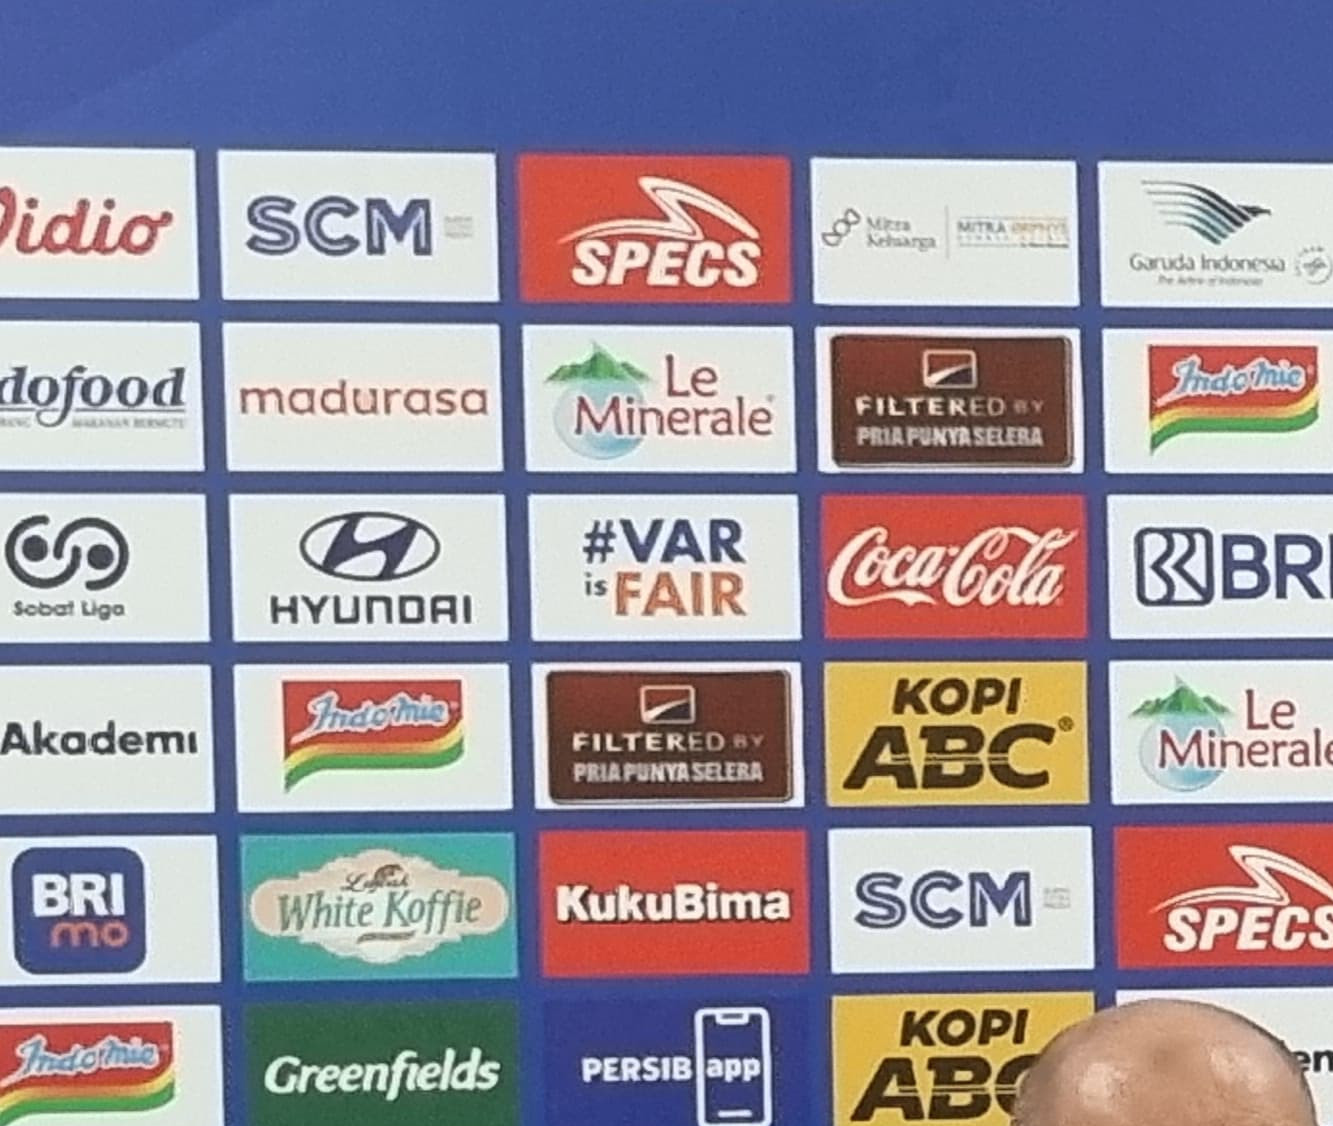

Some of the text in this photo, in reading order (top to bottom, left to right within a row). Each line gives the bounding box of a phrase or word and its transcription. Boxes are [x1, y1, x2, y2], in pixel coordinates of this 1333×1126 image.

[247, 196, 432, 255] SCM
[572, 239, 761, 288] SPECS
[666, 354, 716, 396] Le
[1155, 354, 1305, 402] Indomie
[0, 367, 186, 429] dofood
[240, 380, 488, 416] madurasa
[575, 396, 773, 436] Minerale
[856, 396, 1004, 416] FILTERED
[583, 520, 744, 563] #VAR
[827, 524, 1076, 607] Coca-Cola
[272, 595, 472, 624] HYUNDAI
[585, 573, 744, 617] is FAIR
[291, 691, 448, 742] Indomie
[892, 678, 1022, 714] KOPI
[1246, 690, 1295, 730] Le
[0, 722, 197, 756] Akademi
[573, 732, 725, 752] FILTERED
[843, 724, 1057, 790] ABC
[33, 874, 123, 917] BRI
[278, 887, 482, 930] White Koffie
[557, 887, 789, 923] KukuBima
[855, 871, 1032, 928] SCM
[51, 923, 129, 948] mo
[900, 1009, 1028, 1046] KOPI
[5, 1036, 159, 1088] Indomie
[264, 1048, 500, 1102] Greenfields
[582, 1057, 761, 1083] PERSIB app
